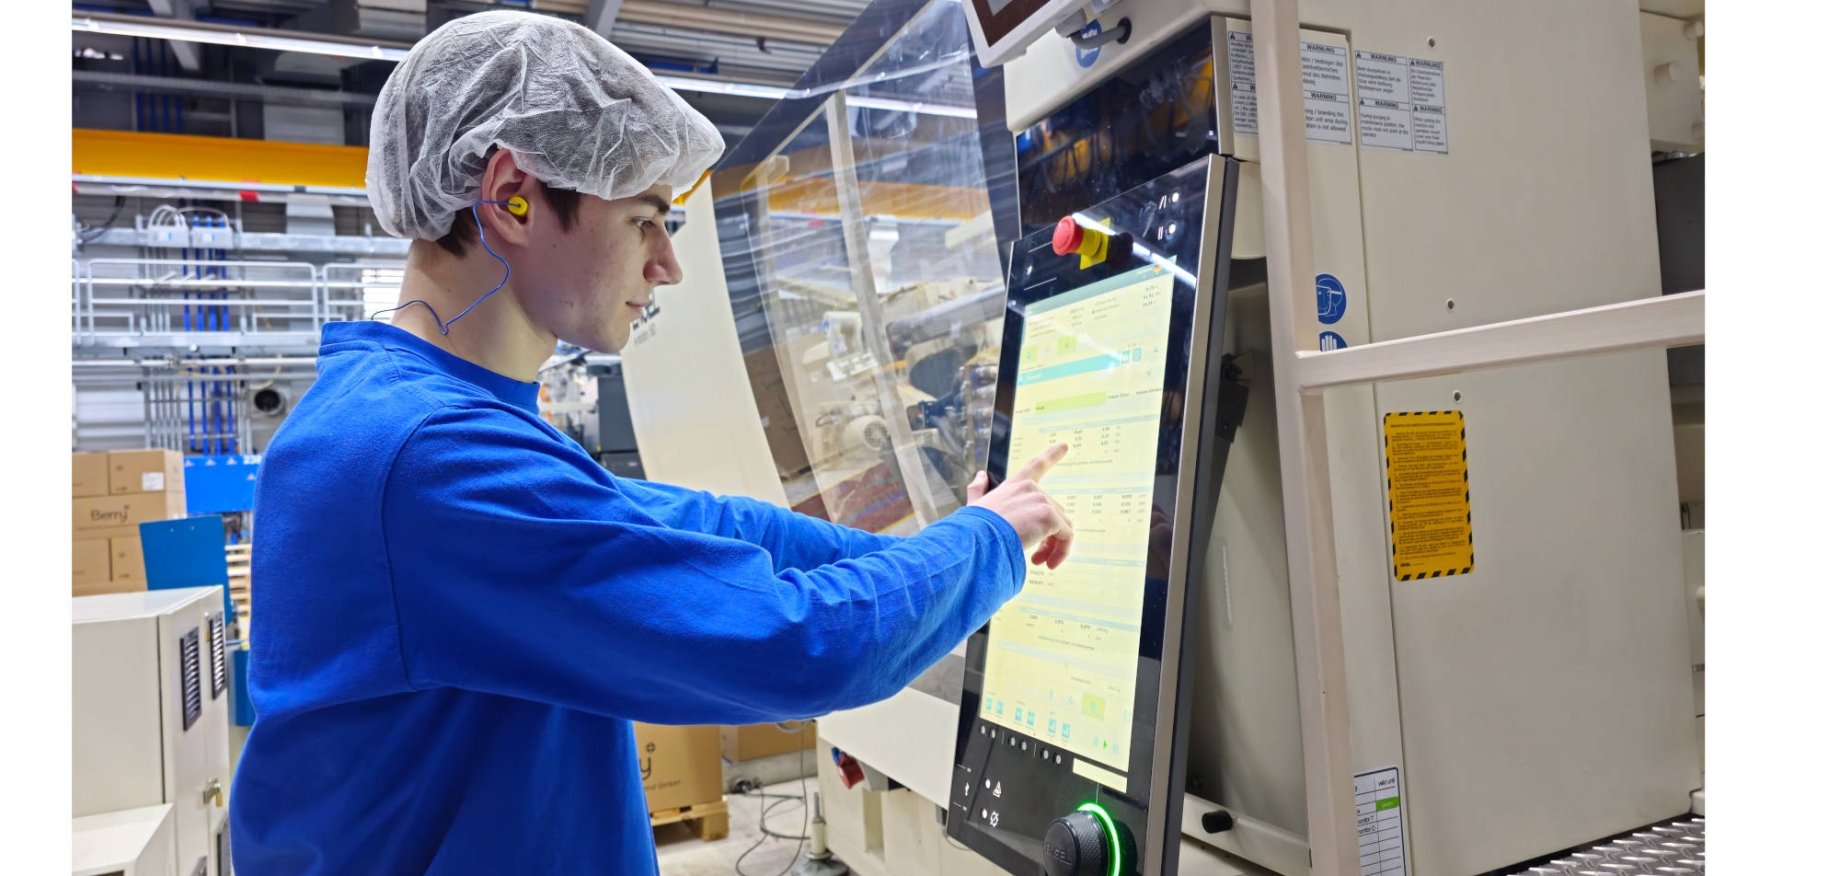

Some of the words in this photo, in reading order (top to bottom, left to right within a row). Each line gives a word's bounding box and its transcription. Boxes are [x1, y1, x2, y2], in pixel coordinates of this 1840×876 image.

[1310, 92, 1337, 101] WARNING
[1375, 101, 1399, 110] WARNING
[1419, 106, 1443, 114] WARNING
[90, 509, 128, 523] Berry
